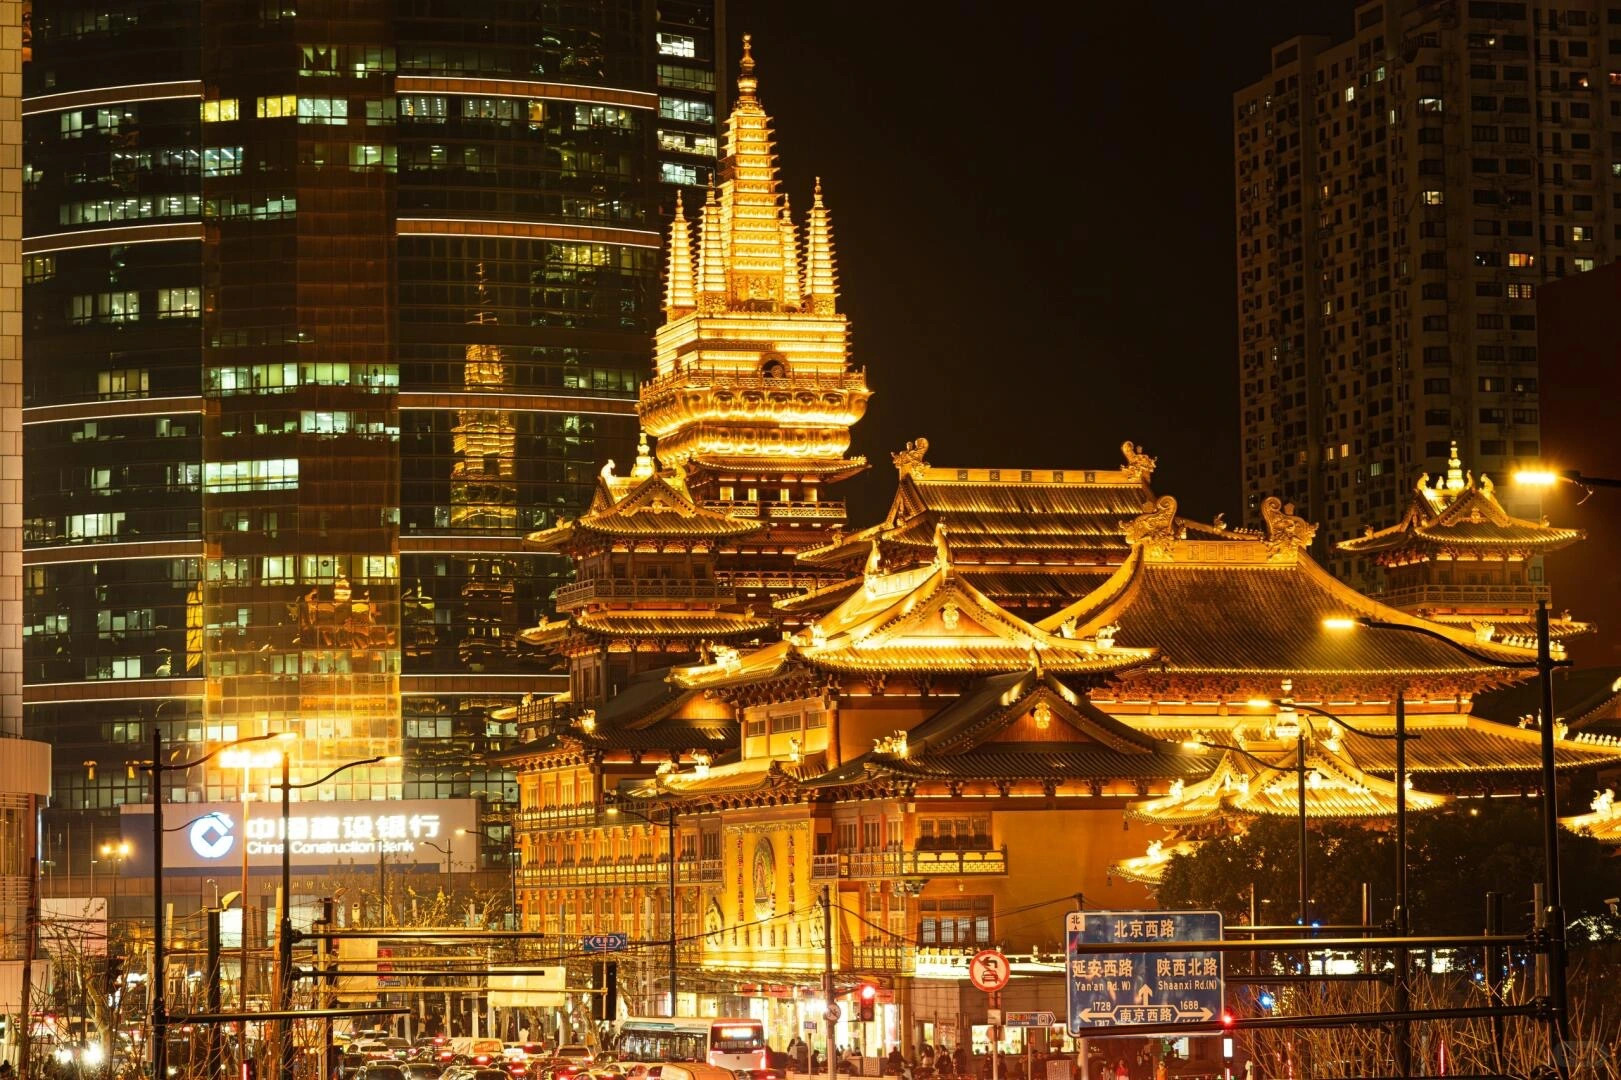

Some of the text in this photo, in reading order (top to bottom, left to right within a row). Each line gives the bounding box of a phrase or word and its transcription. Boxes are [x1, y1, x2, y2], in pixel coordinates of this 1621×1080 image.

[246, 814, 440, 840] 中国建设银行
[290, 841, 375, 854] Construction
[376, 840, 415, 853] Bank
[1071, 915, 1080, 925] 北
[1114, 919, 1175, 938] 北京西路
[1072, 959, 1133, 977] 延安西路
[1156, 957, 1218, 977] 陕西北路
[1075, 981, 1104, 992] Yan'an
[1158, 980, 1192, 991] Shaanxi
[1093, 1001, 1111, 1012] 1728
[1180, 1000, 1199, 1011] 1688
[1119, 1007, 1172, 1023] 南京西路
